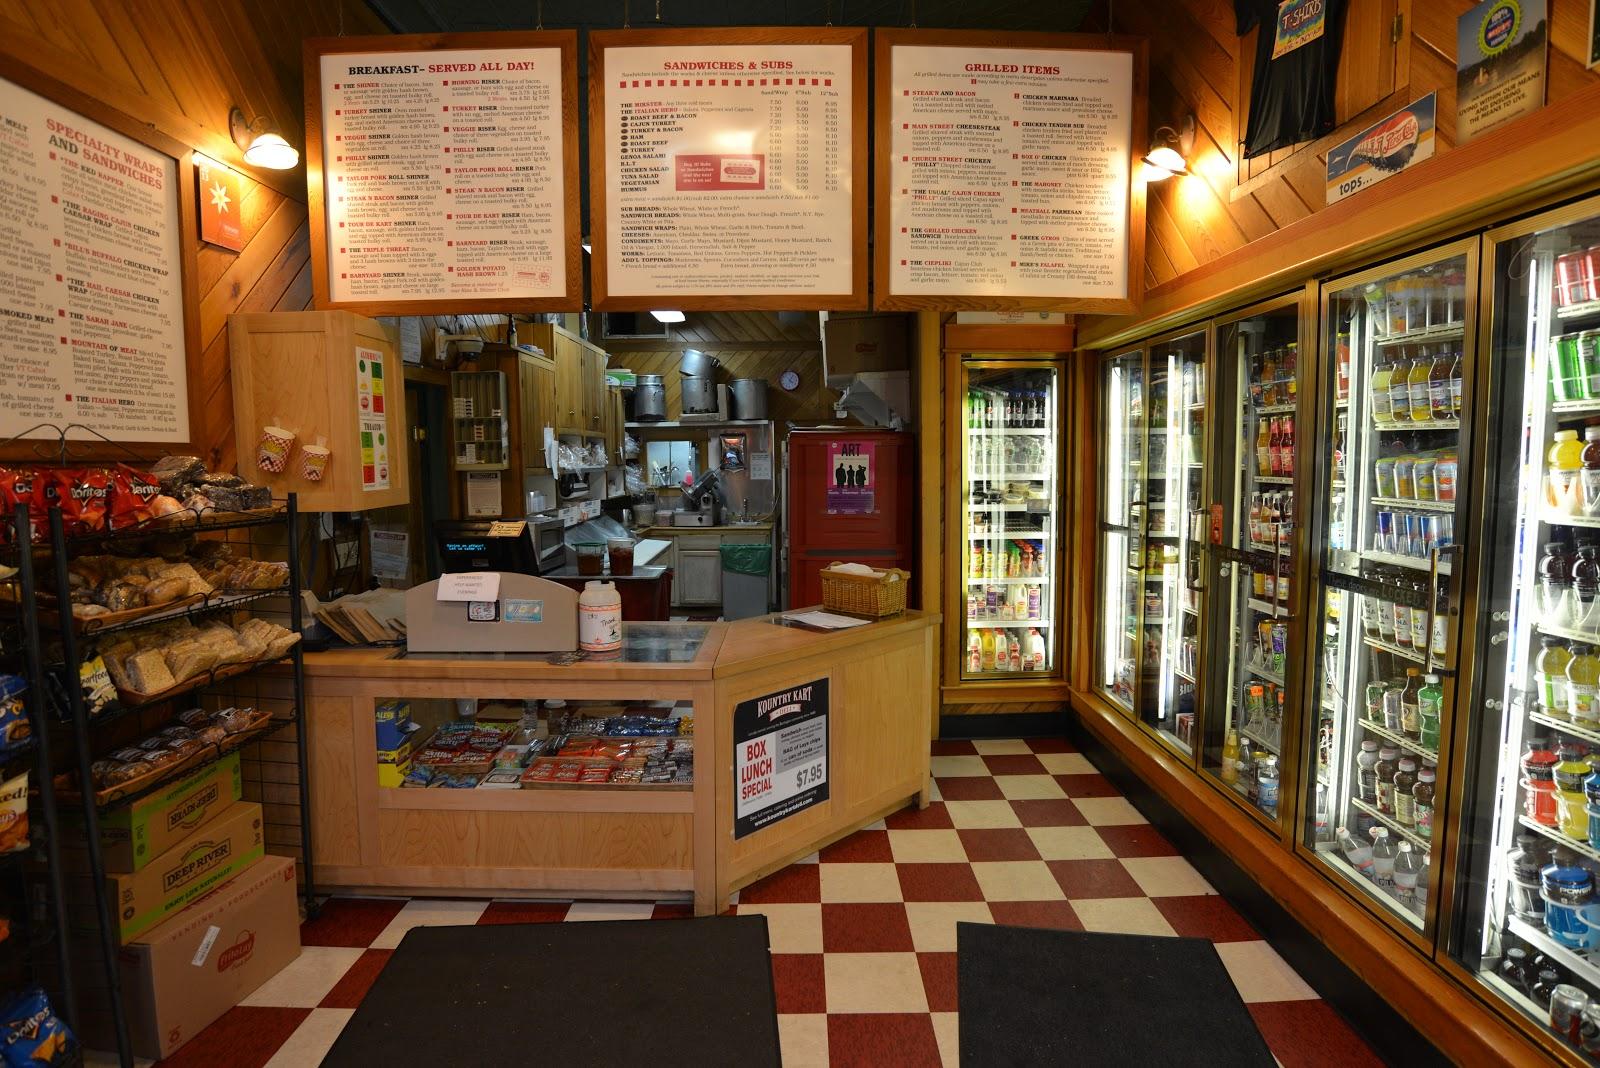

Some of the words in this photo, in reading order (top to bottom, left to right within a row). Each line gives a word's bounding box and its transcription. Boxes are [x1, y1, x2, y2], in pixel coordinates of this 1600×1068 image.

[428, 64, 477, 73] SERVED
[480, 62, 503, 71] ALL
[507, 62, 535, 71] DAY!
[664, 61, 744, 71] SANDWICHES
[748, 61, 757, 70] &
[761, 61, 793, 70] SUBS
[965, 64, 1019, 74] GRILLED
[1022, 65, 1060, 75] ITEMS
[1518, 70, 1541, 86] MEANS
[6, 118, 28, 131] MELT
[46, 118, 121, 162] SPECIALTY
[123, 151, 164, 179] WRAPS
[49, 134, 79, 154] AND
[82, 147, 163, 191] SANDWICHES
[1339, 176, 1373, 197] tops...
[64, 207, 92, 221] CAESAR
[93, 216, 113, 228] WRAP
[82, 206, 109, 221] RAGING
[110, 216, 132, 229] CAJUN
[133, 223, 160, 238] CHICKEN
[91, 248, 122, 264] BUFFALO
[123, 259, 151, 272] CHICKEN
[152, 265, 169, 277] WRAP
[68, 284, 88, 295] WRAP
[105, 286, 132, 298] CAESAR
[132, 292, 160, 305] CHICKEN
[0, 308, 32, 321] SMOKED
[34, 313, 55, 325] MEAT
[69, 311, 84, 320] THE
[86, 315, 110, 326] SARAH
[111, 319, 128, 329] JANE
[71, 339, 108, 351] MOUNTAIN
[109, 344, 119, 352] OF
[120, 346, 138, 355] MEAT
[76, 395, 90, 403] THE
[91, 396, 117, 405] ITALIAN
[118, 398, 135, 406] HERO
[841, 443, 862, 457] ART
[757, 692, 792, 718] KOUNTRY
[793, 686, 812, 702] KART
[747, 740, 766, 761] BOX
[741, 757, 773, 785] LUNCH
[796, 762, 823, 788] $7.95
[742, 777, 773, 800] SPECIAL
[165, 865, 195, 889] DEEP
[195, 847, 230, 873] RIVER
[7, 1007, 50, 1045] Doritos
